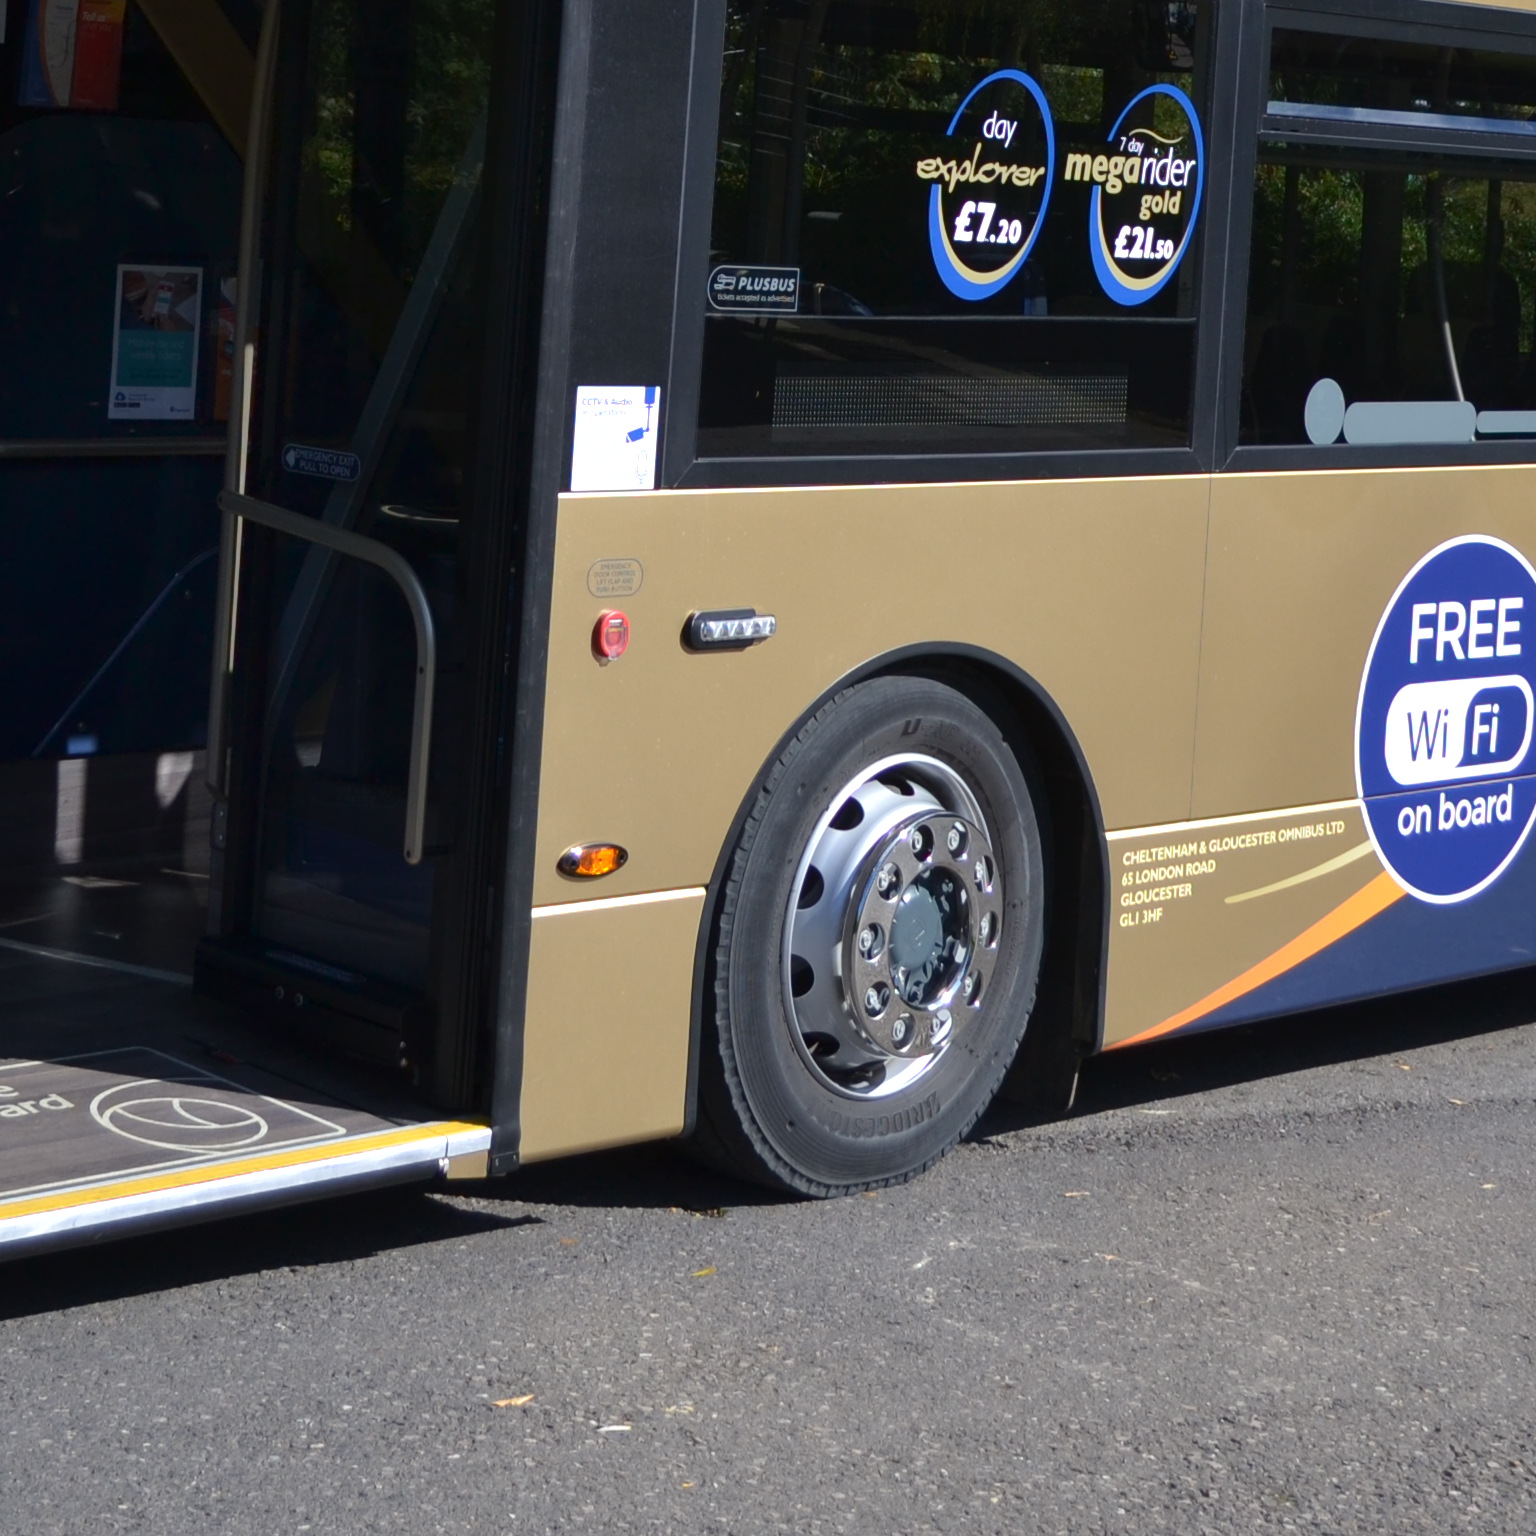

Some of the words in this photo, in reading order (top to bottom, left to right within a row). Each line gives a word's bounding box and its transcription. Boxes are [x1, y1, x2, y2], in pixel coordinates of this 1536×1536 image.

[982, 109, 1018, 149] day
[1119, 135, 1127, 152] 7
[1127, 136, 1145, 156] day
[916, 141, 1046, 194] explorer
[1064, 145, 1197, 195] megarider
[952, 200, 1023, 245] £7.20
[1139, 189, 1182, 222] gold
[1113, 224, 1174, 260] £21.50
[737, 276, 796, 292] PLUSBUS
[295, 448, 337, 463] EMERGENCY
[338, 455, 355, 466] EXIT
[299, 460, 317, 472] PULL
[319, 462, 329, 473] TO
[330, 464, 351, 477] OPEN
[1408, 596, 1524, 664] FREE
[1397, 805, 1433, 837] on
[1437, 783, 1514, 832] board
[1122, 841, 1198, 866] CHELTENHAM
[1199, 840, 1207, 855] &
[1208, 830, 1276, 853] GLOUCESTER
[1278, 822, 1325, 843] OMNIBUS
[1326, 820, 1346, 836] LTD
[1121, 872, 1134, 887] 65
[1135, 864, 1184, 885] LONDON
[1185, 859, 1216, 875] ROAD
[1120, 883, 1193, 907] GLOUCESTER
[1119, 911, 1140, 928] GL1
[1141, 908, 1163, 924] 3HF
